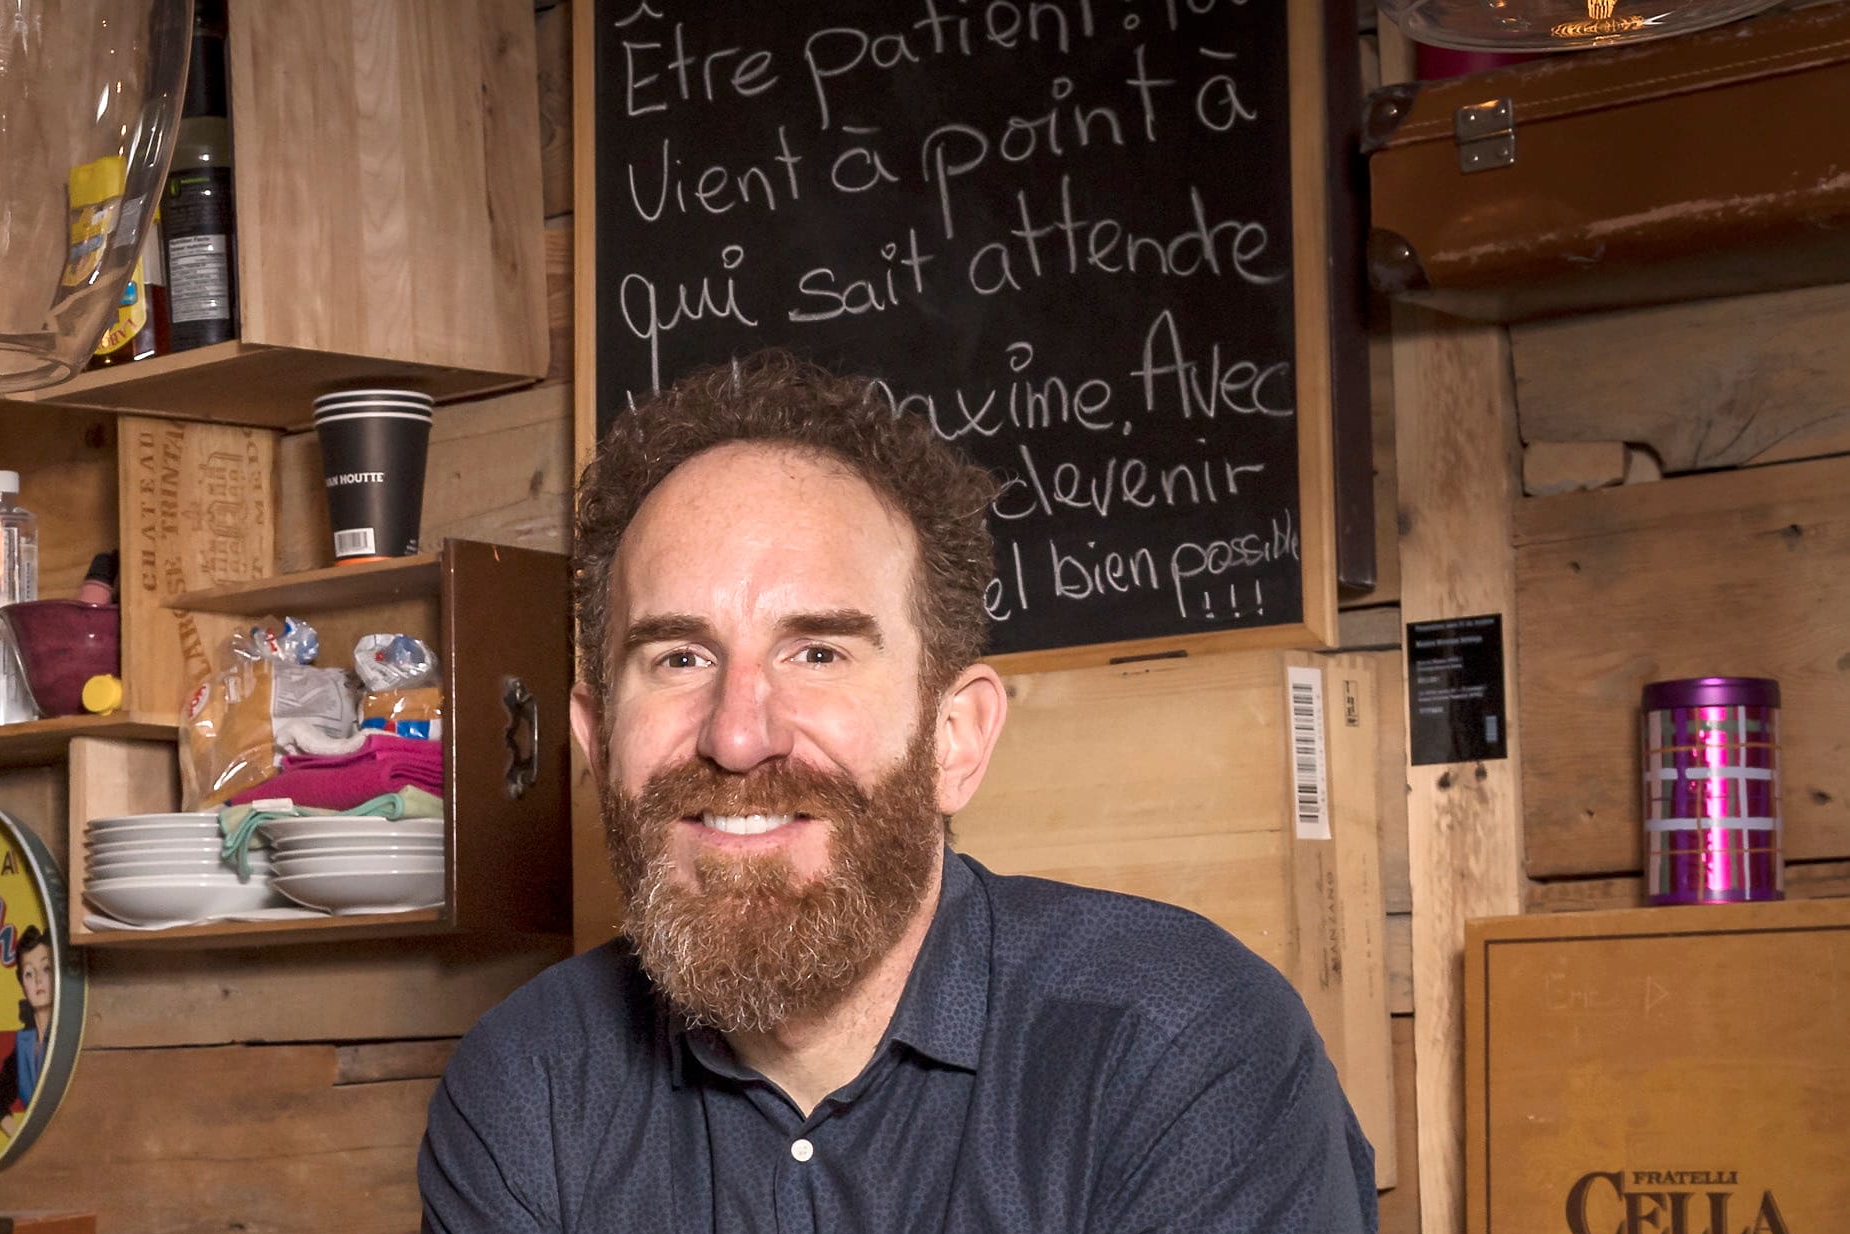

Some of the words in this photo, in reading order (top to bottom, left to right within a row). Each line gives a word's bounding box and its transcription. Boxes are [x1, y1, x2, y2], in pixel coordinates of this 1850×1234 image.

[922, 43, 1176, 240] point
[621, 244, 758, 397] qui
[1131, 310, 1295, 419] Avec
[339, 472, 385, 485] HOUTTE
[992, 438, 1264, 519] devenir
[1049, 538, 1159, 601] bien
[1632, 1170, 1738, 1186] FRATELLI
